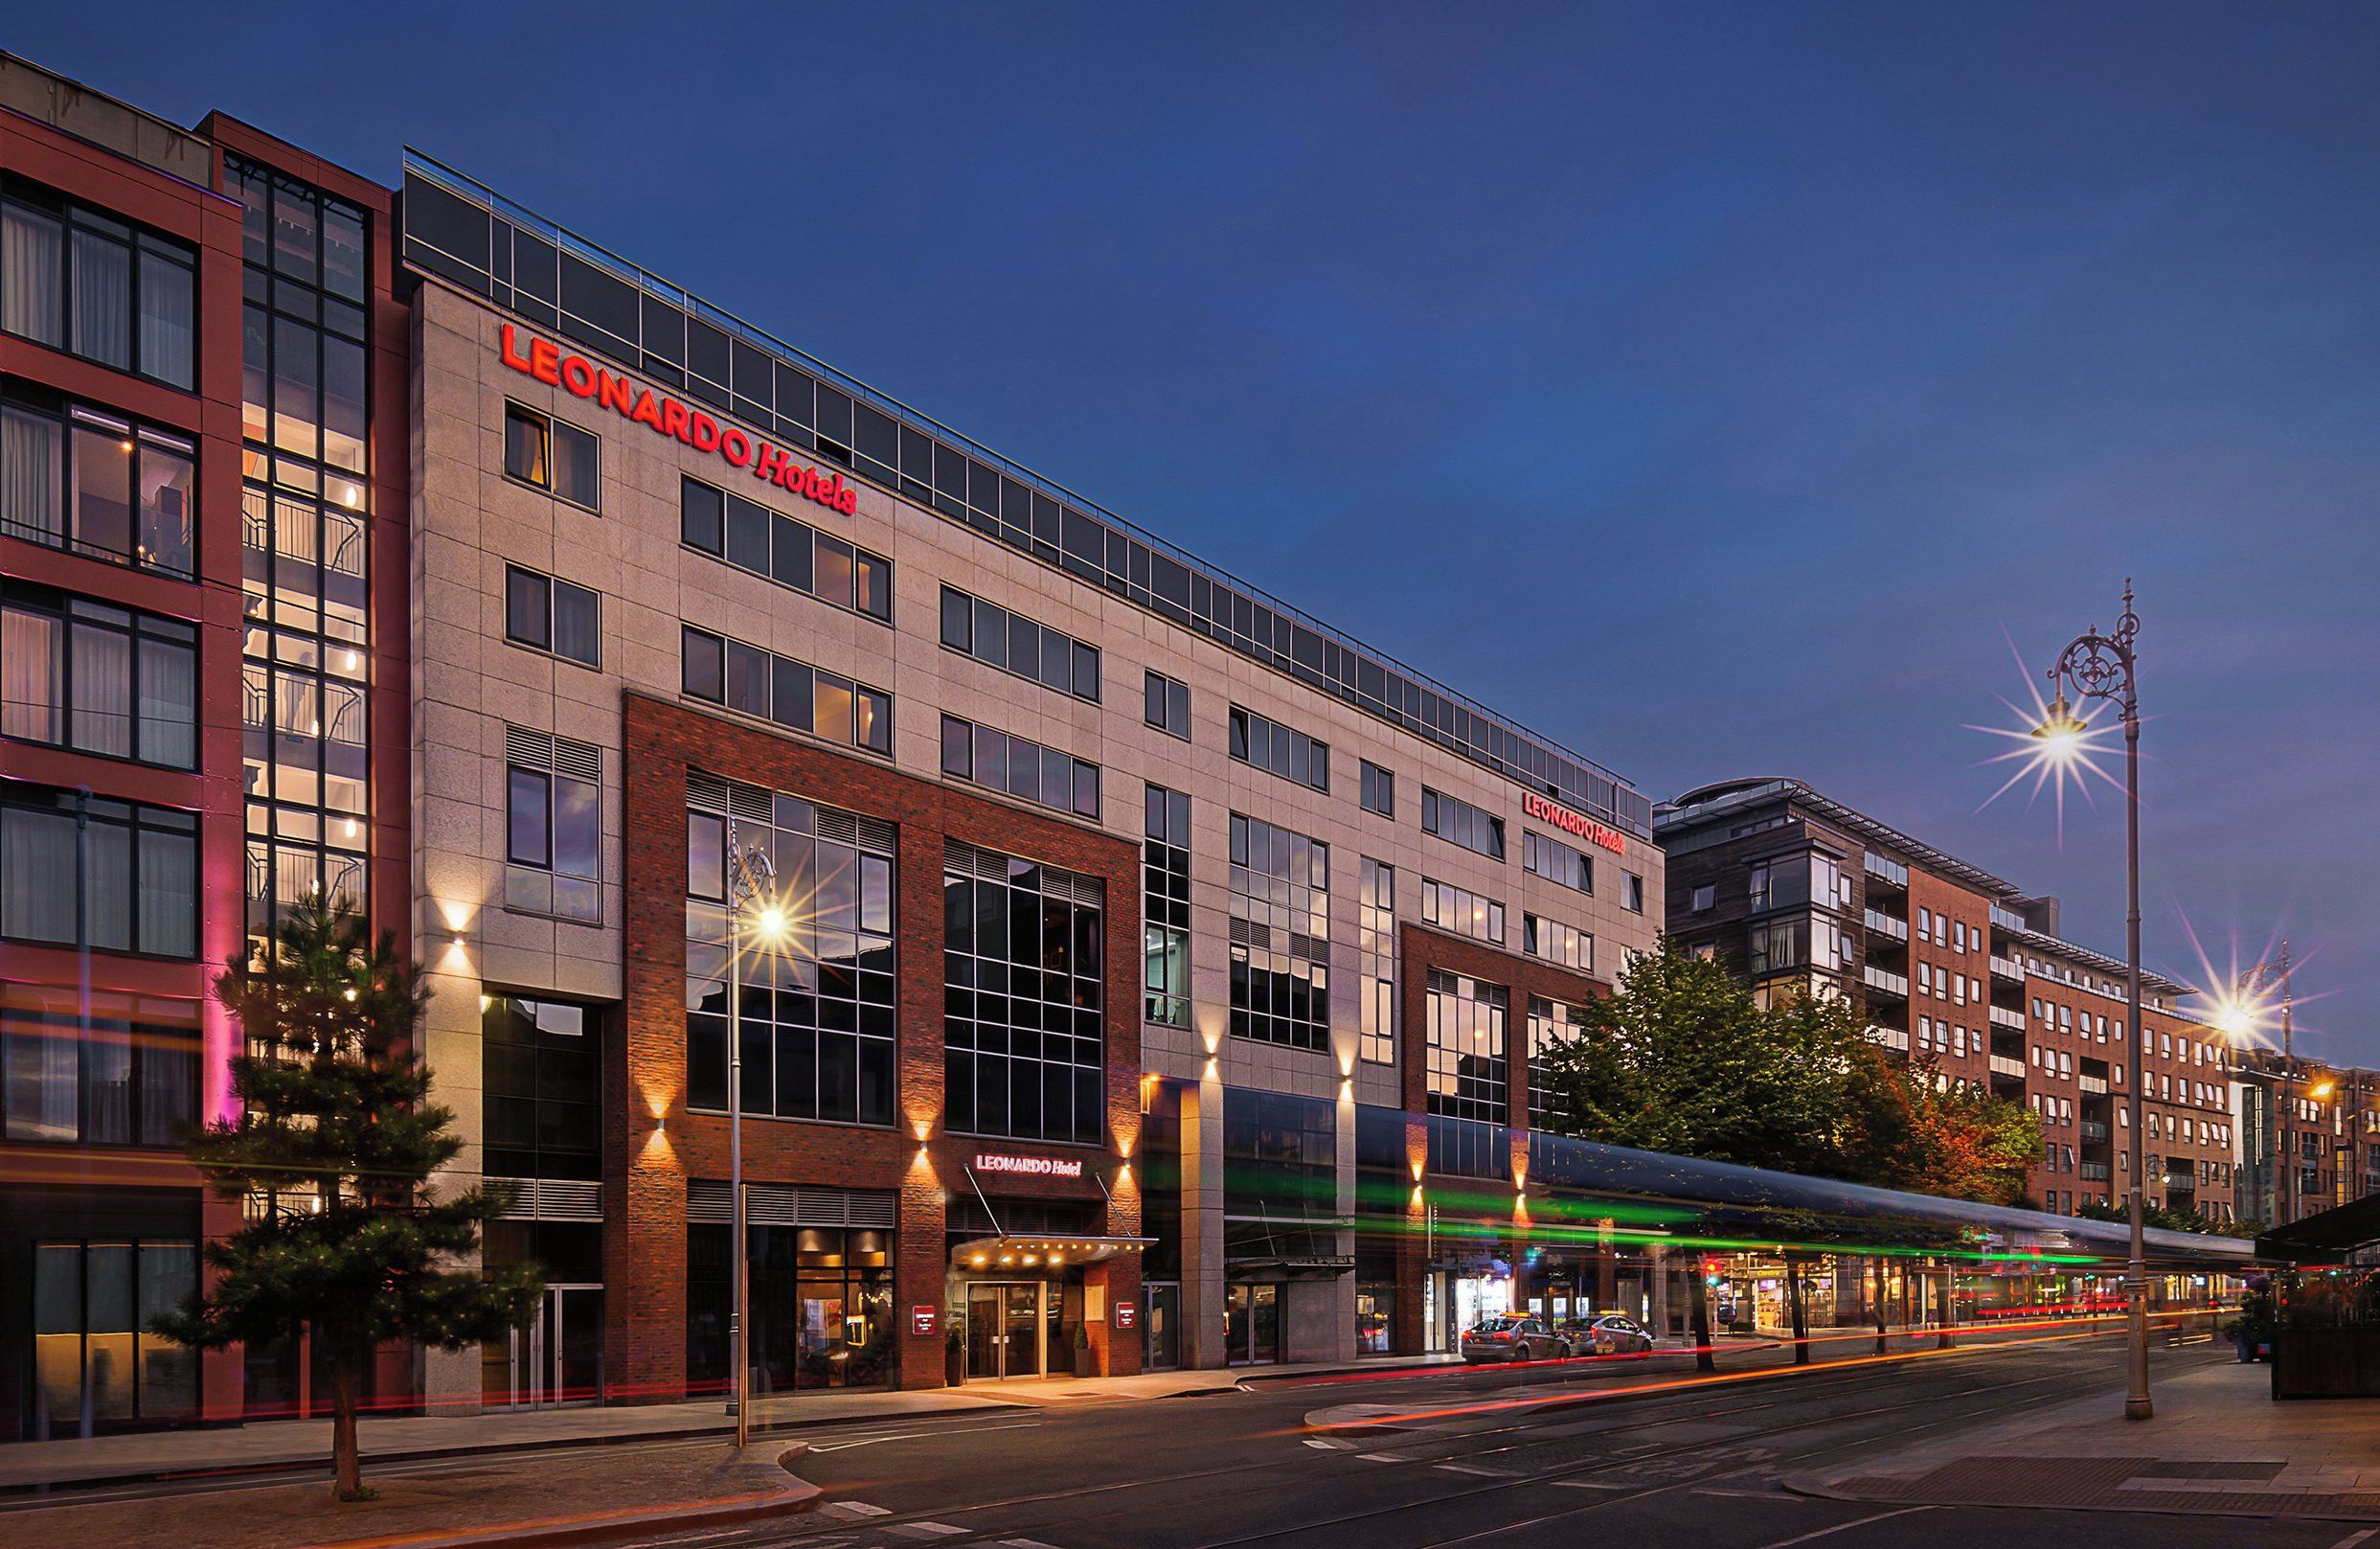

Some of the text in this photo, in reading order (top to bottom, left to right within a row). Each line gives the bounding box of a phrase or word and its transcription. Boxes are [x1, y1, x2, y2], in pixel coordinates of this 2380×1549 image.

[501, 322, 859, 515] LEONARDO Hotels
[1523, 790, 1626, 855] LEONARDO Hotels
[976, 1154, 1082, 1176] LEONARDO Hotel
